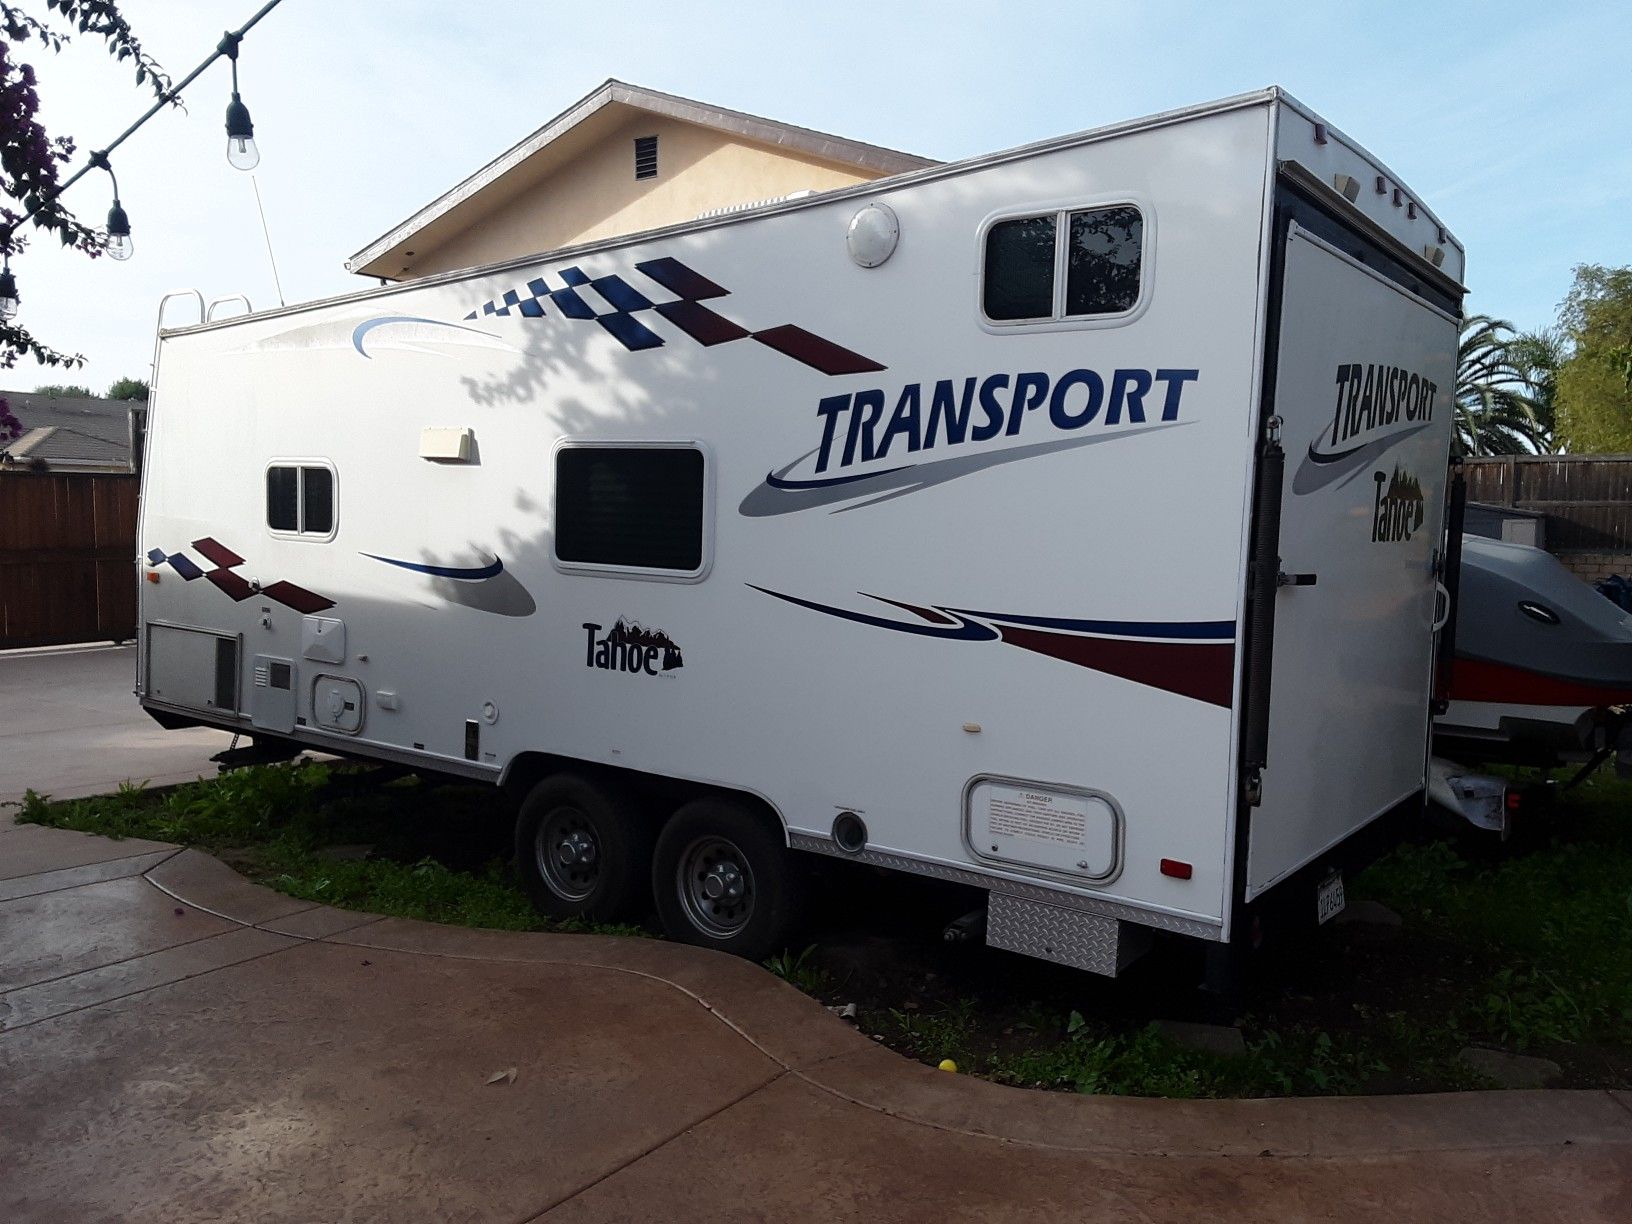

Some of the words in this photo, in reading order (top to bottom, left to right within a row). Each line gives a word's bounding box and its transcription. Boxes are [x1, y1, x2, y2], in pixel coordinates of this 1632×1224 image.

[815, 368, 1200, 475] TRANSPORT
[1331, 363, 1437, 447] TRANSPORT
[1371, 470, 1414, 543] Tahoe
[582, 622, 659, 676] Tahoe
[1025, 793, 1053, 803] DANGER
